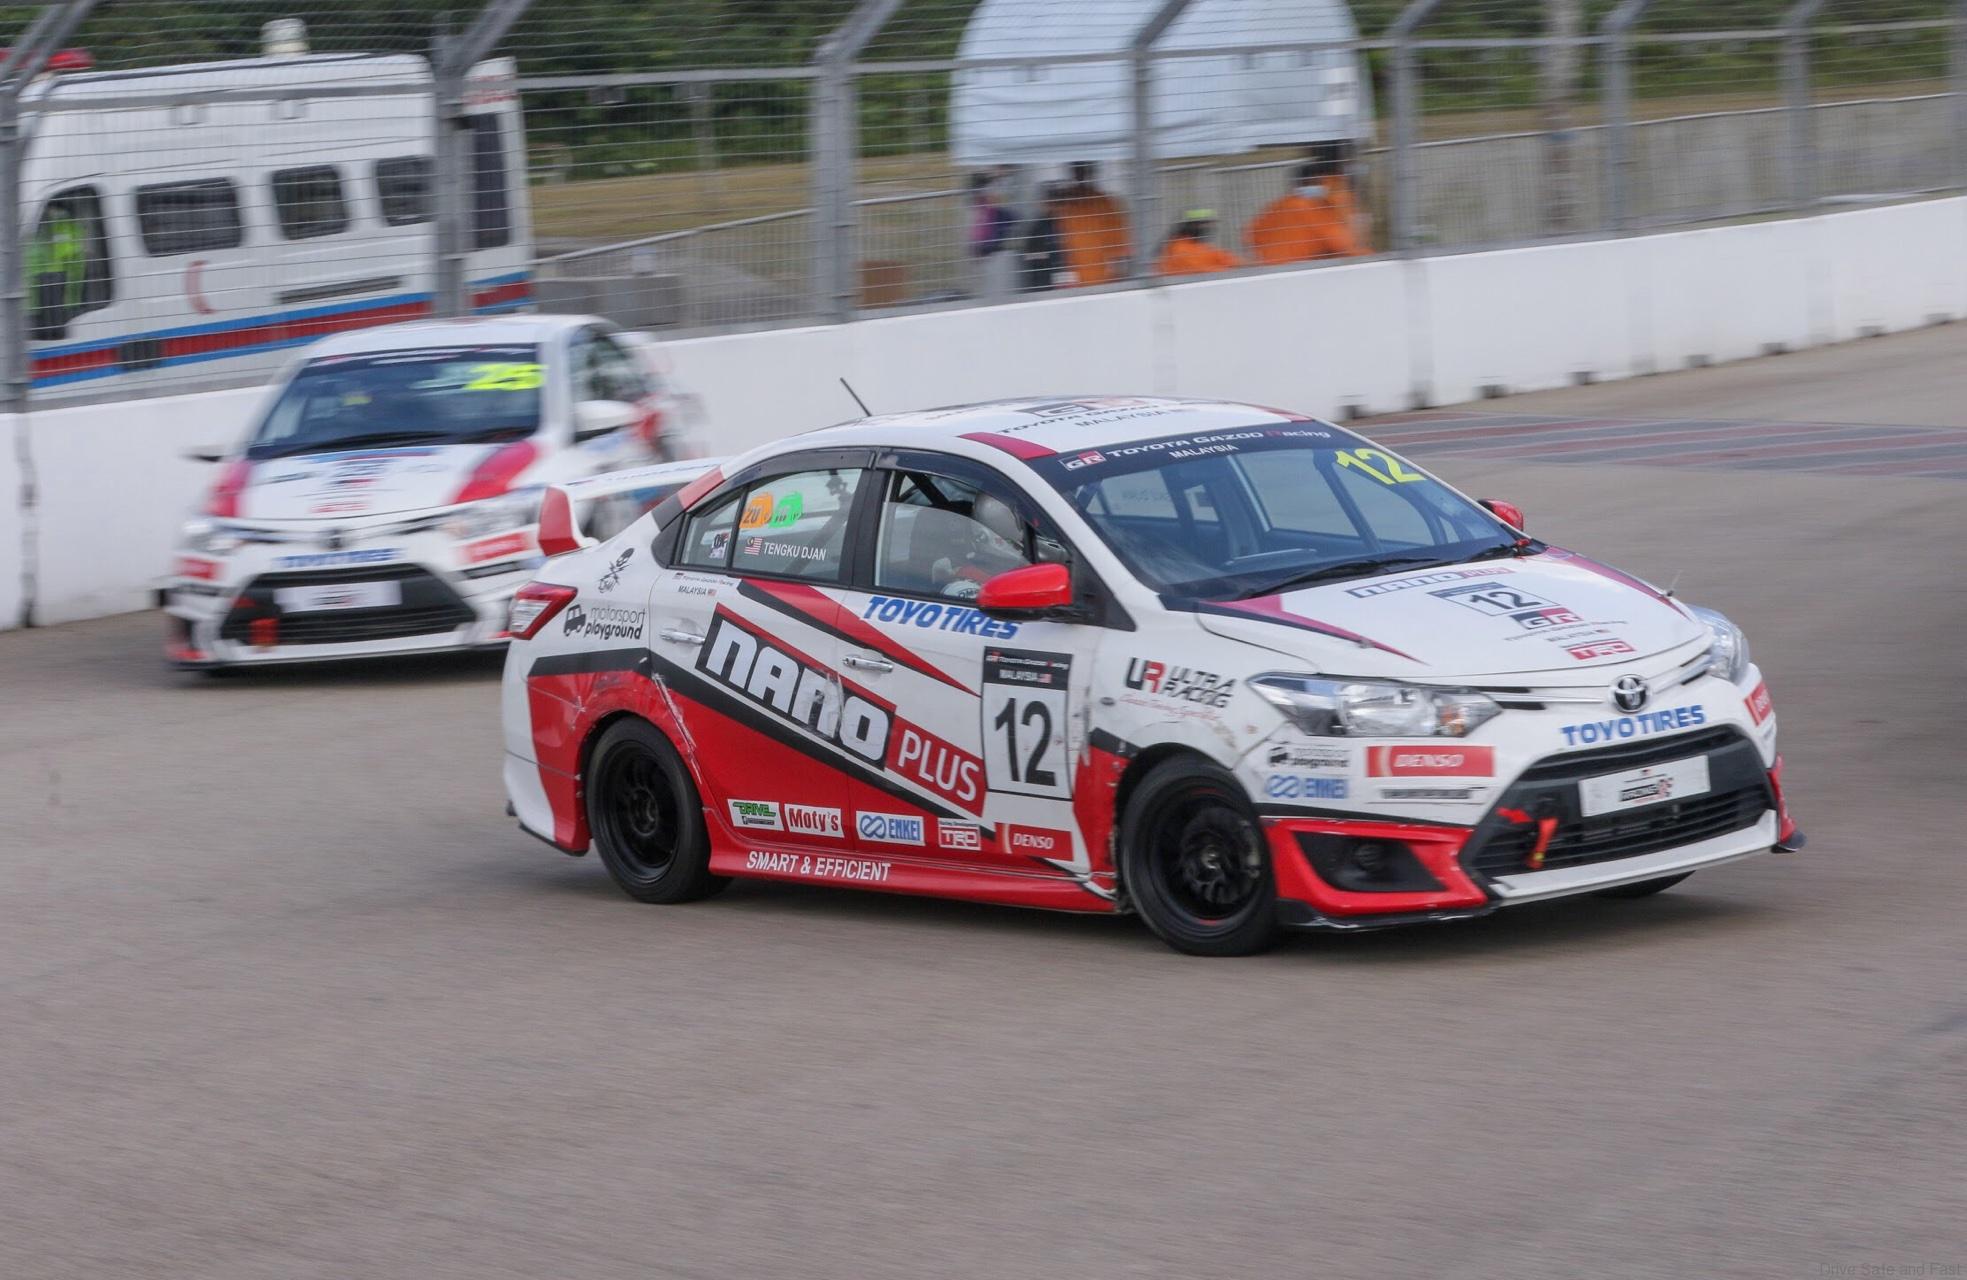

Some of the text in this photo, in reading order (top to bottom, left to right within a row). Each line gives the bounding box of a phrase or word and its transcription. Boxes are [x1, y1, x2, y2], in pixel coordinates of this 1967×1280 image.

[1106, 440, 1190, 458] TOYOTA
[1193, 430, 1264, 444] GAZOO
[1169, 443, 1240, 459] MALAYSIA
[1335, 448, 1428, 485] 12
[763, 542, 827, 561] TENGKU DJAN
[678, 585, 707, 596] MALAYSIA
[1468, 591, 1543, 610] 12
[590, 606, 646, 623] motorsport
[584, 621, 643, 640] playground
[1125, 657, 1166, 693] UR
[995, 697, 1057, 787] 12
[898, 728, 981, 802] PLUS
[1393, 753, 1465, 768] DENSO
[788, 808, 839, 832] Moty's
[888, 818, 921, 841] ENKEI
[941, 829, 978, 847] TRD
[1013, 832, 1055, 850] DENSO
[746, 850, 891, 882] SMART & EFFICIENT
